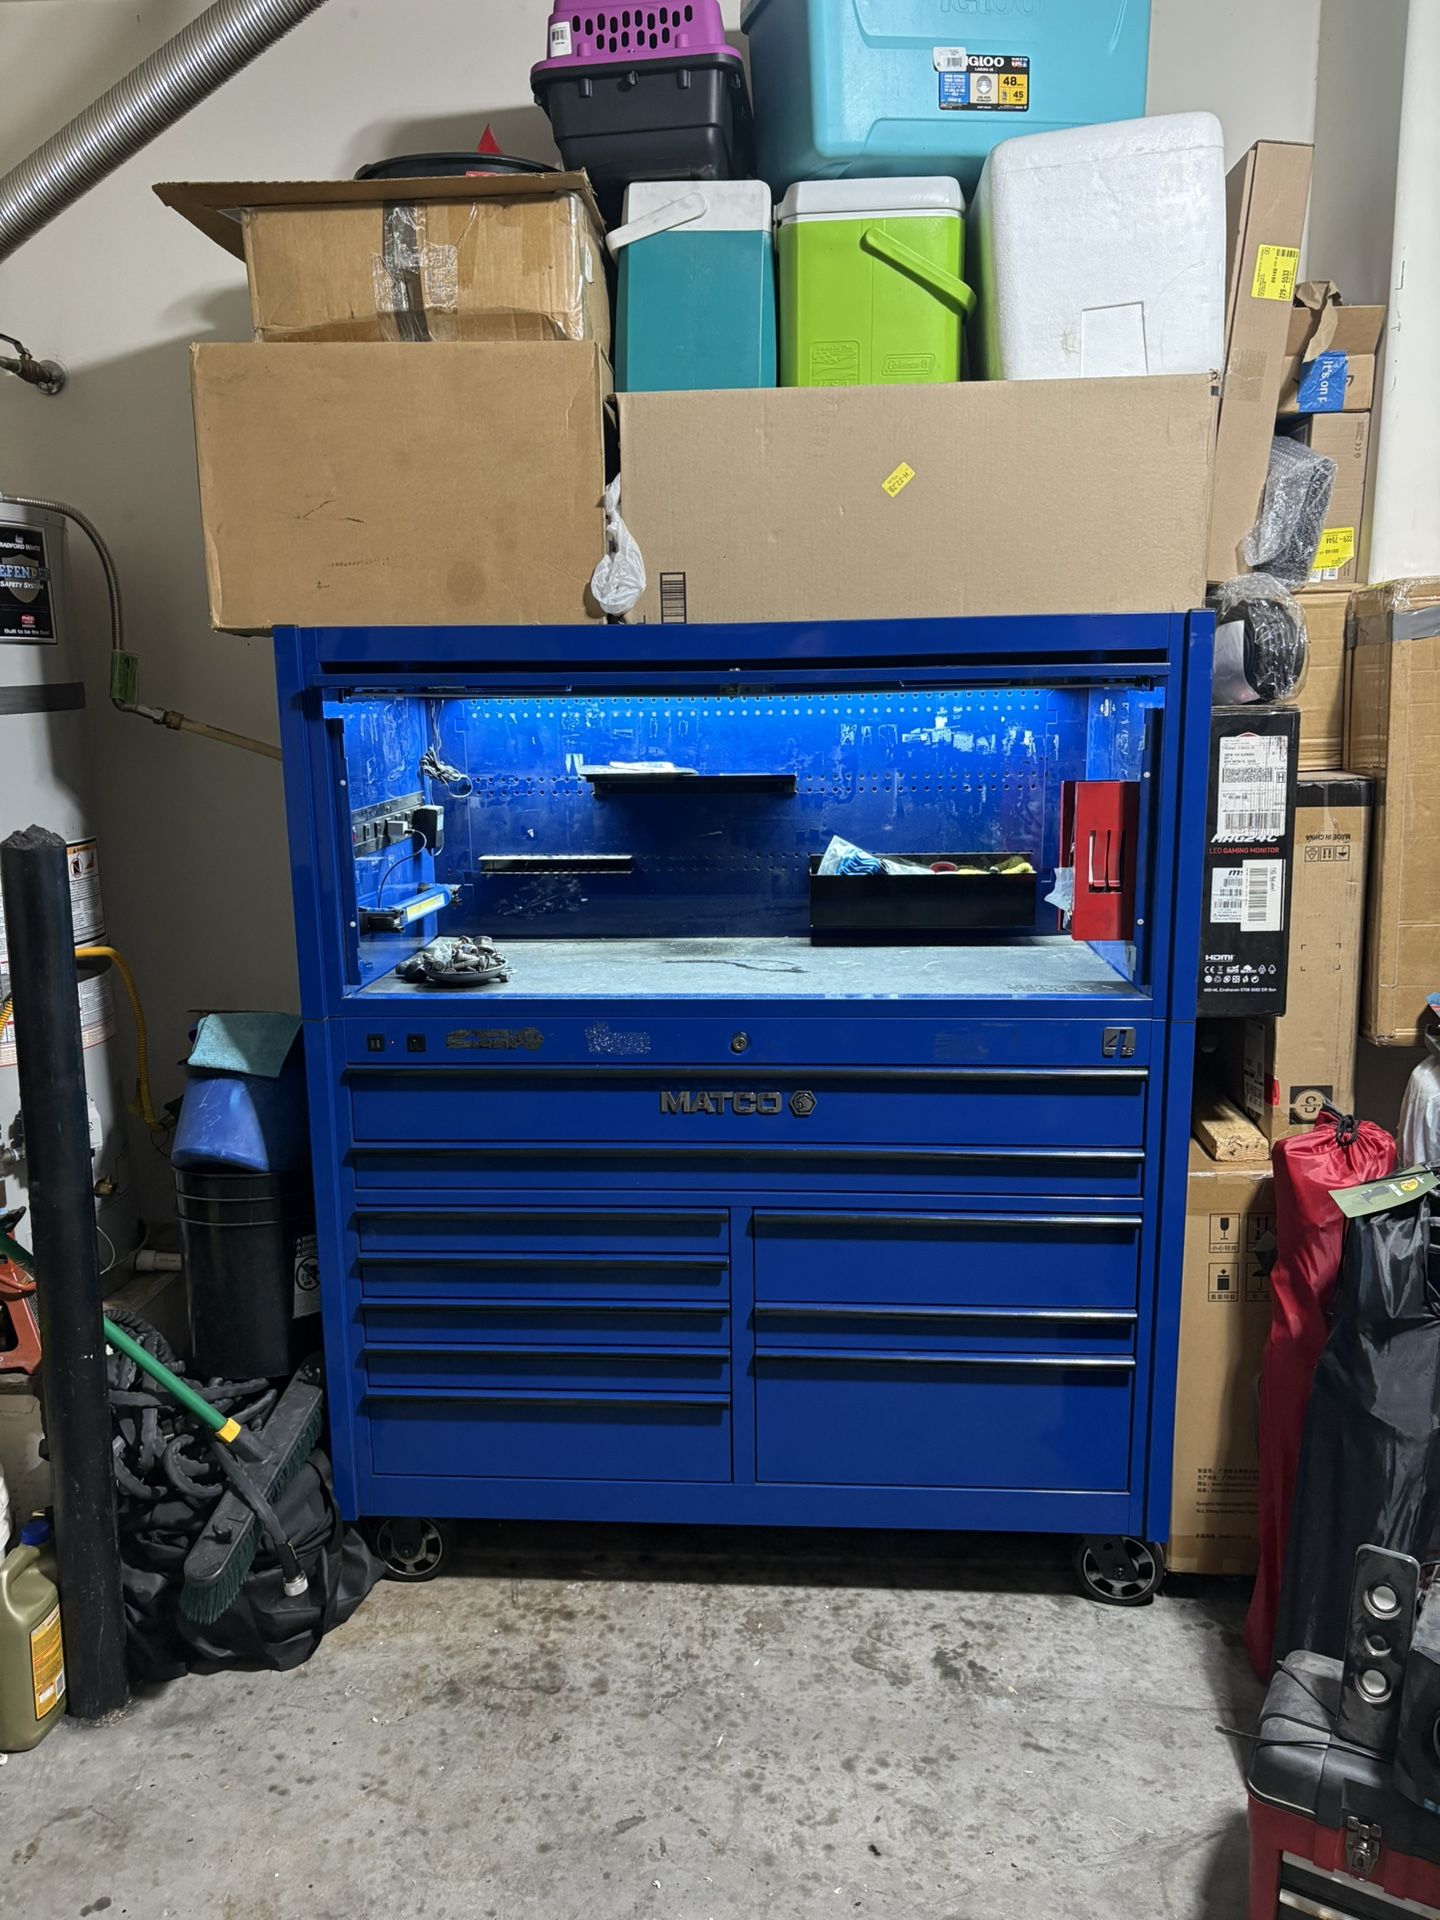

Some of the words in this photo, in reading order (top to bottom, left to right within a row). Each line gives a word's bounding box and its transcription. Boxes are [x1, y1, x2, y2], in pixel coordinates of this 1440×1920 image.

[1003, 76, 1017, 86] 48
[1013, 91, 1024, 99] 45
[1319, 380, 1329, 395] on
[0, 580, 23, 588] SAFETY
[1333, 833, 1351, 841] MADE
[1250, 846, 1280, 854] MONITOR
[660, 1090, 783, 1114] MATCO
